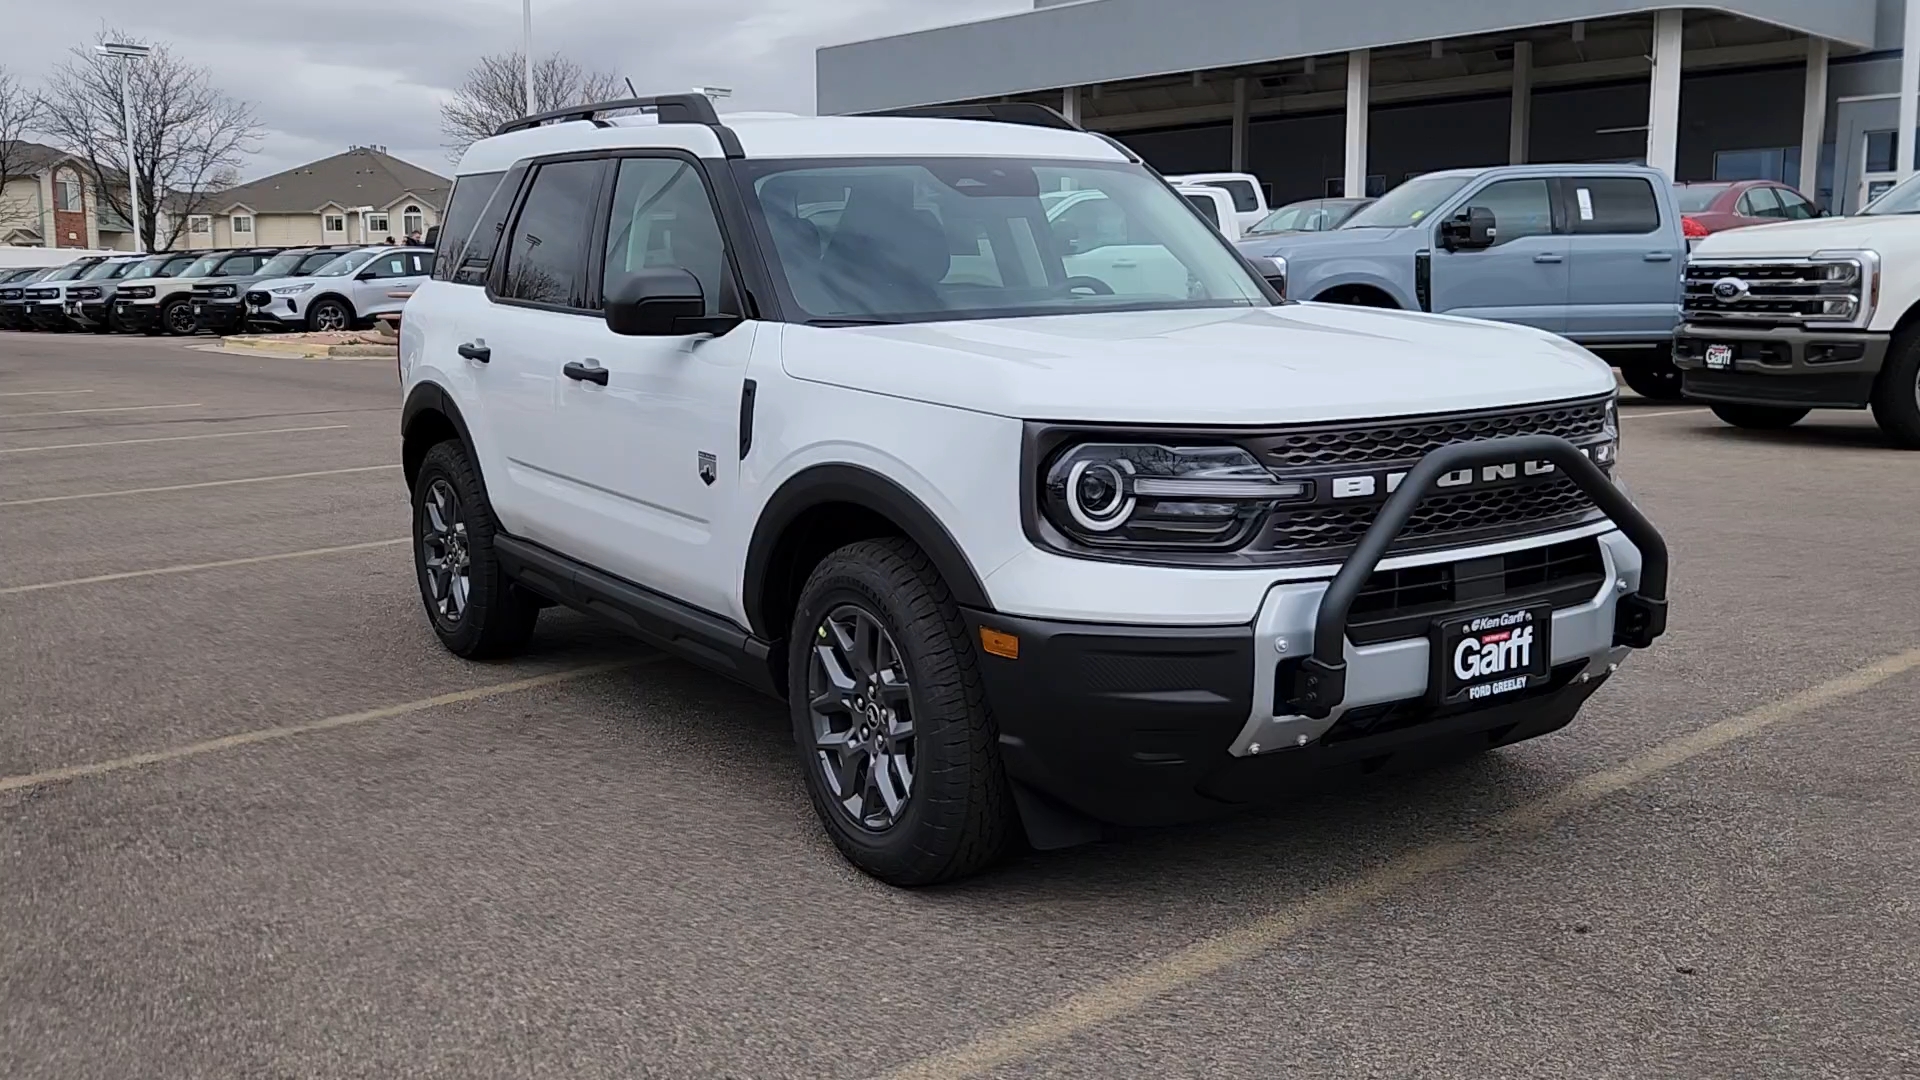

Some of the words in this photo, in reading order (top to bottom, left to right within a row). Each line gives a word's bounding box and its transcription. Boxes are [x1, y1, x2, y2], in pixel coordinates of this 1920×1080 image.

[1332, 448, 1589, 498] BONC
[1480, 617, 1500, 630] Ken
[1500, 610, 1525, 625] Garff
[1454, 626, 1533, 680] Garff
[1470, 684, 1491, 699] FORD
[1492, 676, 1527, 695] GREELEY
